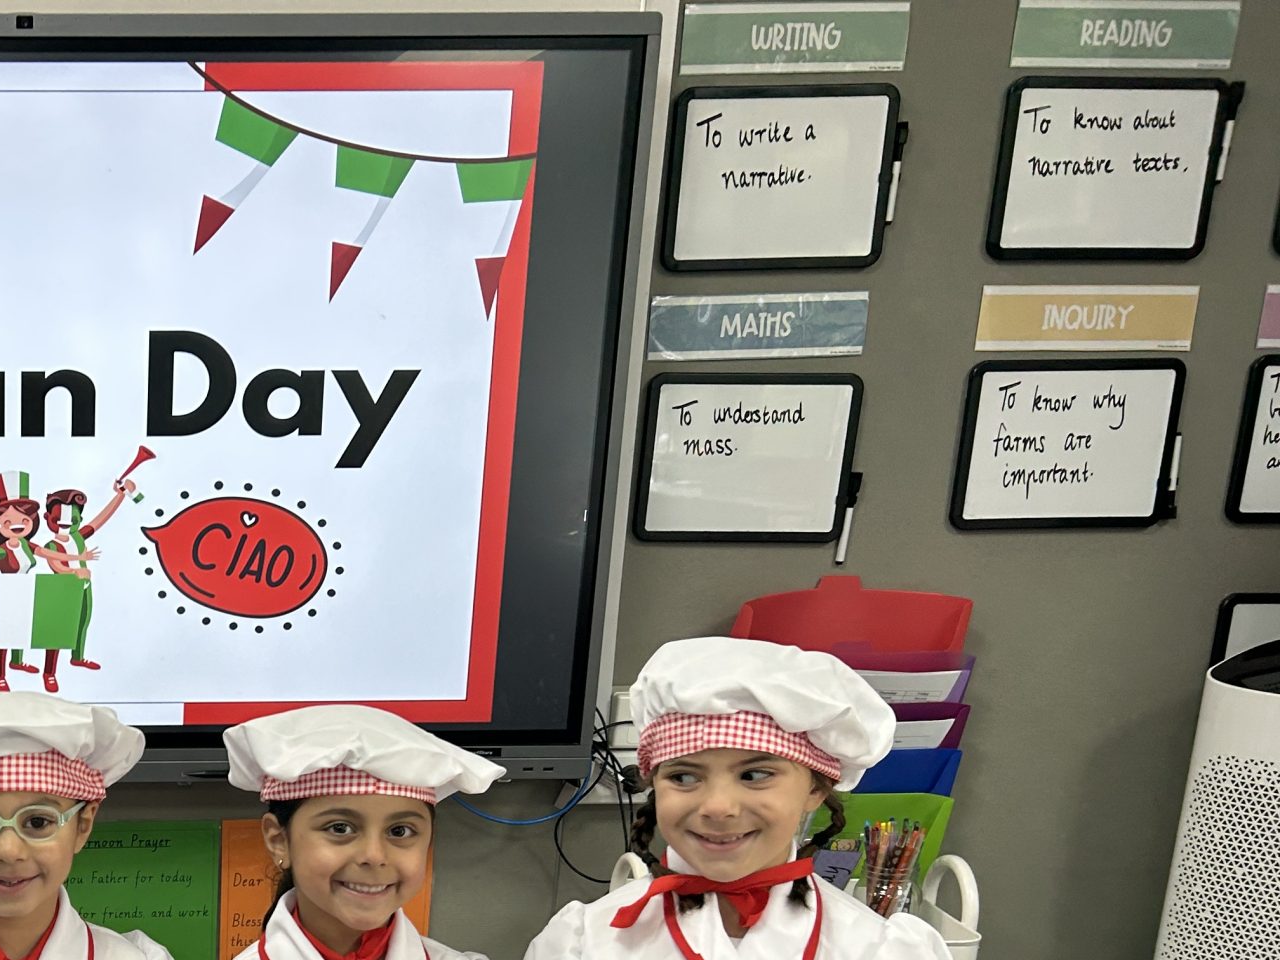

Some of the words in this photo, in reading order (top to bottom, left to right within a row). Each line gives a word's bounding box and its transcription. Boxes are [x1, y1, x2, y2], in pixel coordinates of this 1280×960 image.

[751, 22, 842, 51] WRITING
[1080, 19, 1173, 48] READING
[696, 112, 723, 148] To
[739, 121, 793, 147] write
[805, 124, 817, 141] a
[1023, 105, 1051, 134] To
[1074, 107, 1122, 131] know
[1133, 108, 1176, 131] about
[722, 164, 811, 190] narrative.
[1028, 156, 1114, 178] narrative
[720, 311, 796, 339] MATHS
[1042, 304, 1135, 331] INQUIRY
[147, 330, 422, 470] Day
[672, 400, 698, 426] To
[713, 401, 805, 425] understand
[999, 381, 1022, 411] To
[1032, 385, 1077, 412] know
[1093, 384, 1126, 430] why
[684, 438, 738, 456] mass.
[993, 422, 1046, 457] farms
[1064, 433, 1092, 451] are
[1002, 461, 1094, 500] important.
[131, 834, 171, 853] Prayer
[91, 870, 128, 885] Father
[135, 870, 154, 889] for
[160, 870, 192, 888] today
[233, 872, 263, 887] Dear
[151, 906, 172, 918] and
[179, 905, 209, 918] work
[232, 913, 262, 928] Bless
